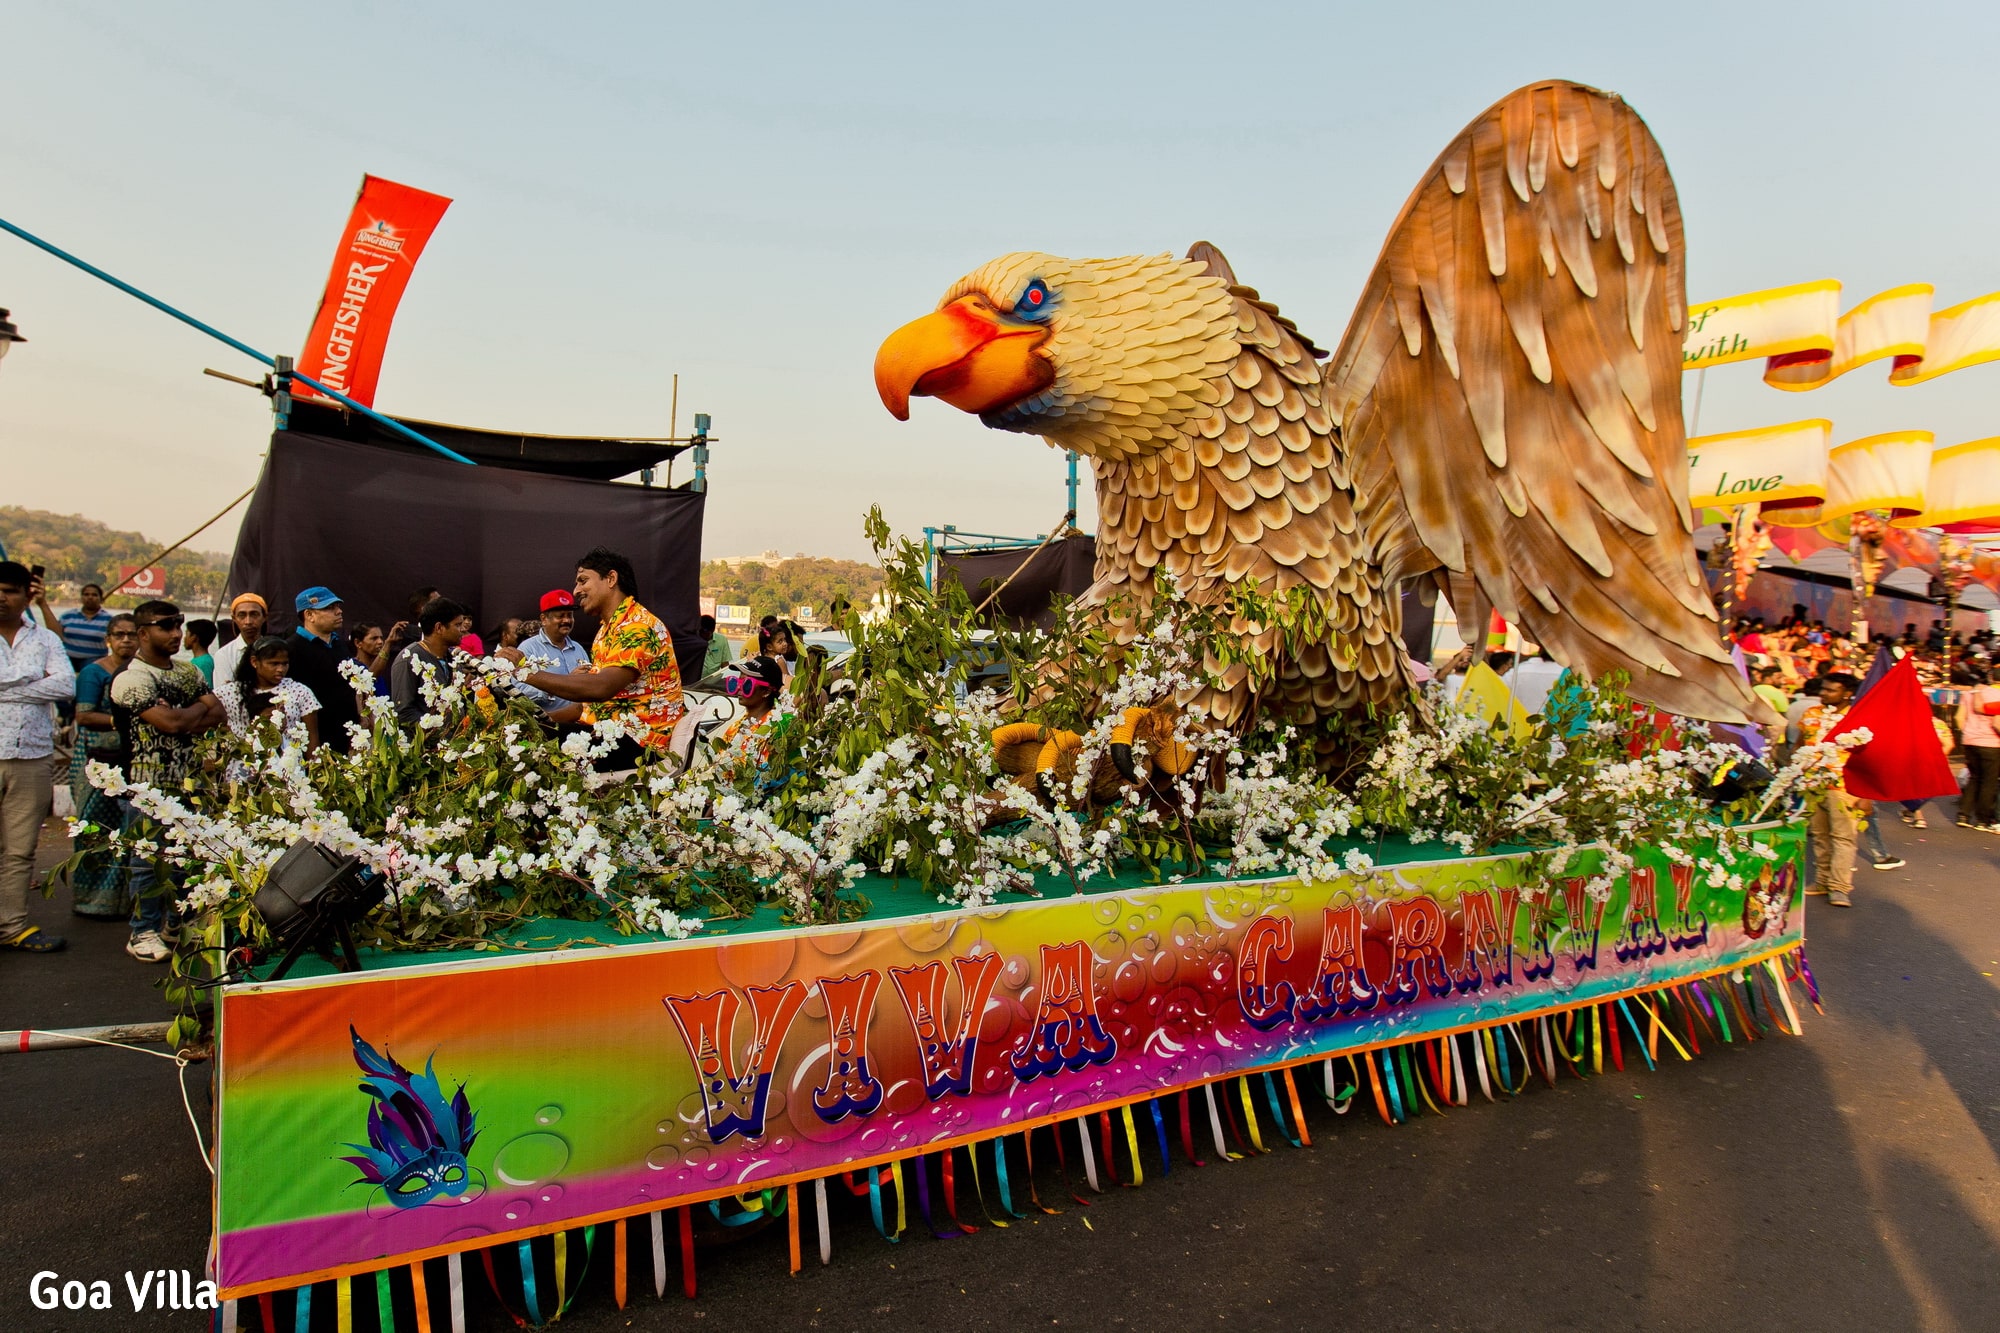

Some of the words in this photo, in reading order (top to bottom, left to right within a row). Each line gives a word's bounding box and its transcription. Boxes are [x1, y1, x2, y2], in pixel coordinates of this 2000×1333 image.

[357, 231, 401, 251] KINGFISHER
[1683, 333, 1748, 362] with
[1716, 472, 1783, 497] Love
[122, 586, 163, 596] vodafone
[731, 607, 748, 618] LIC
[662, 940, 1118, 1145] VIVA
[1238, 863, 1708, 1031] CARNIVAL
